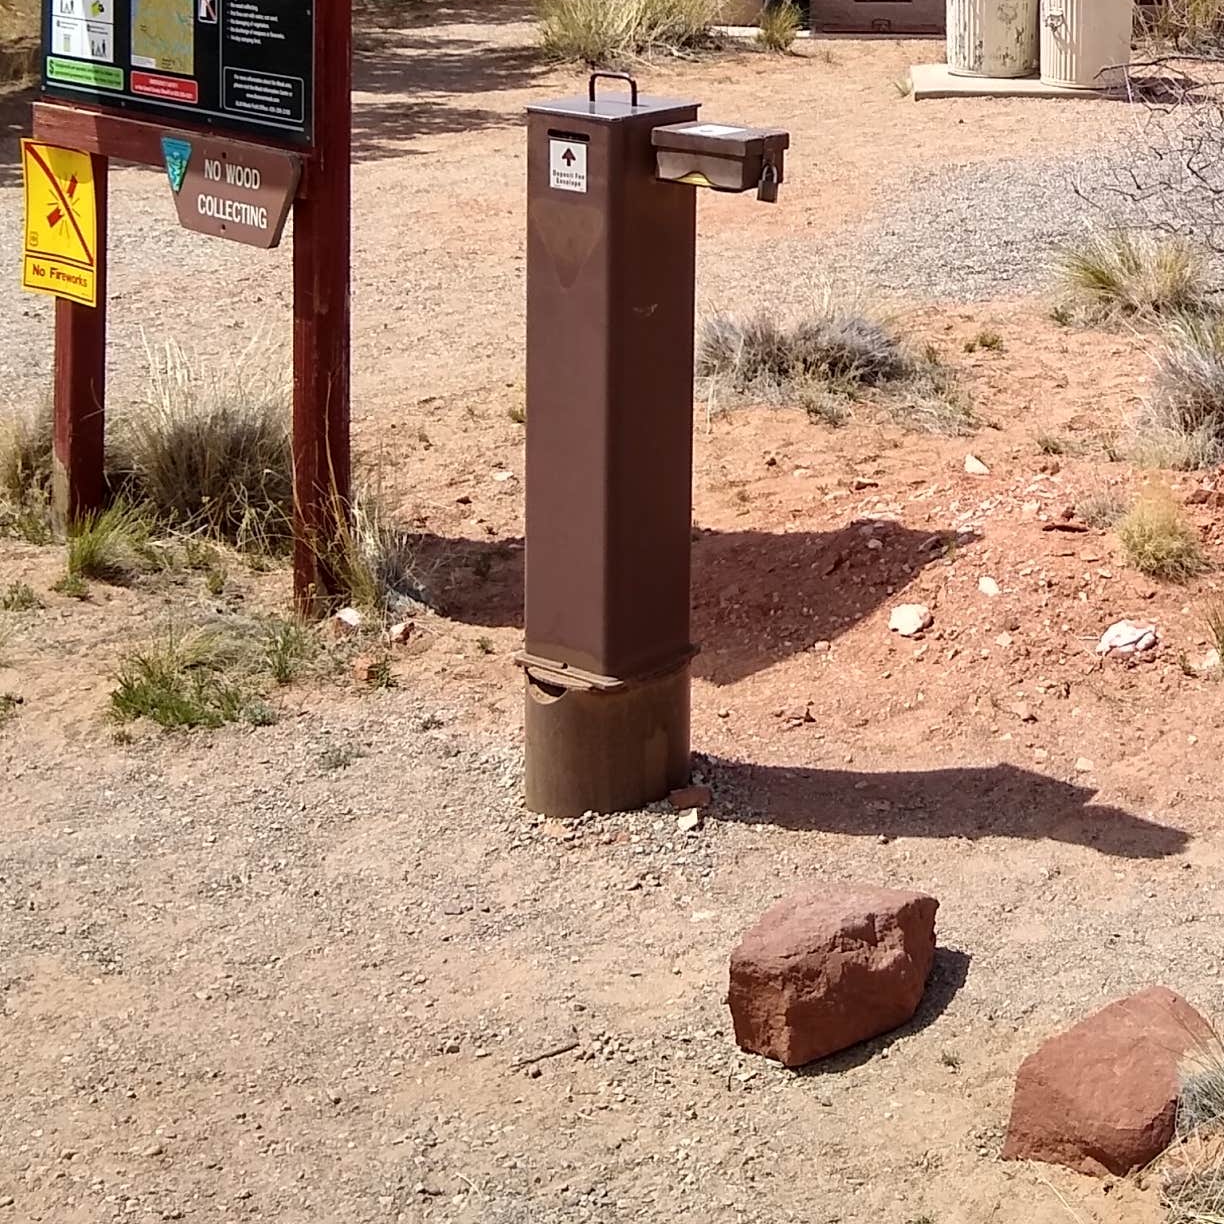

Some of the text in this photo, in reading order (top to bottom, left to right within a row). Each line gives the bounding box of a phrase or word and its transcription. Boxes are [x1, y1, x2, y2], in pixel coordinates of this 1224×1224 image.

[204, 159, 261, 190] NO WOOD
[197, 194, 268, 229] COLLECTING
[32, 264, 88, 288] No Fireworks
